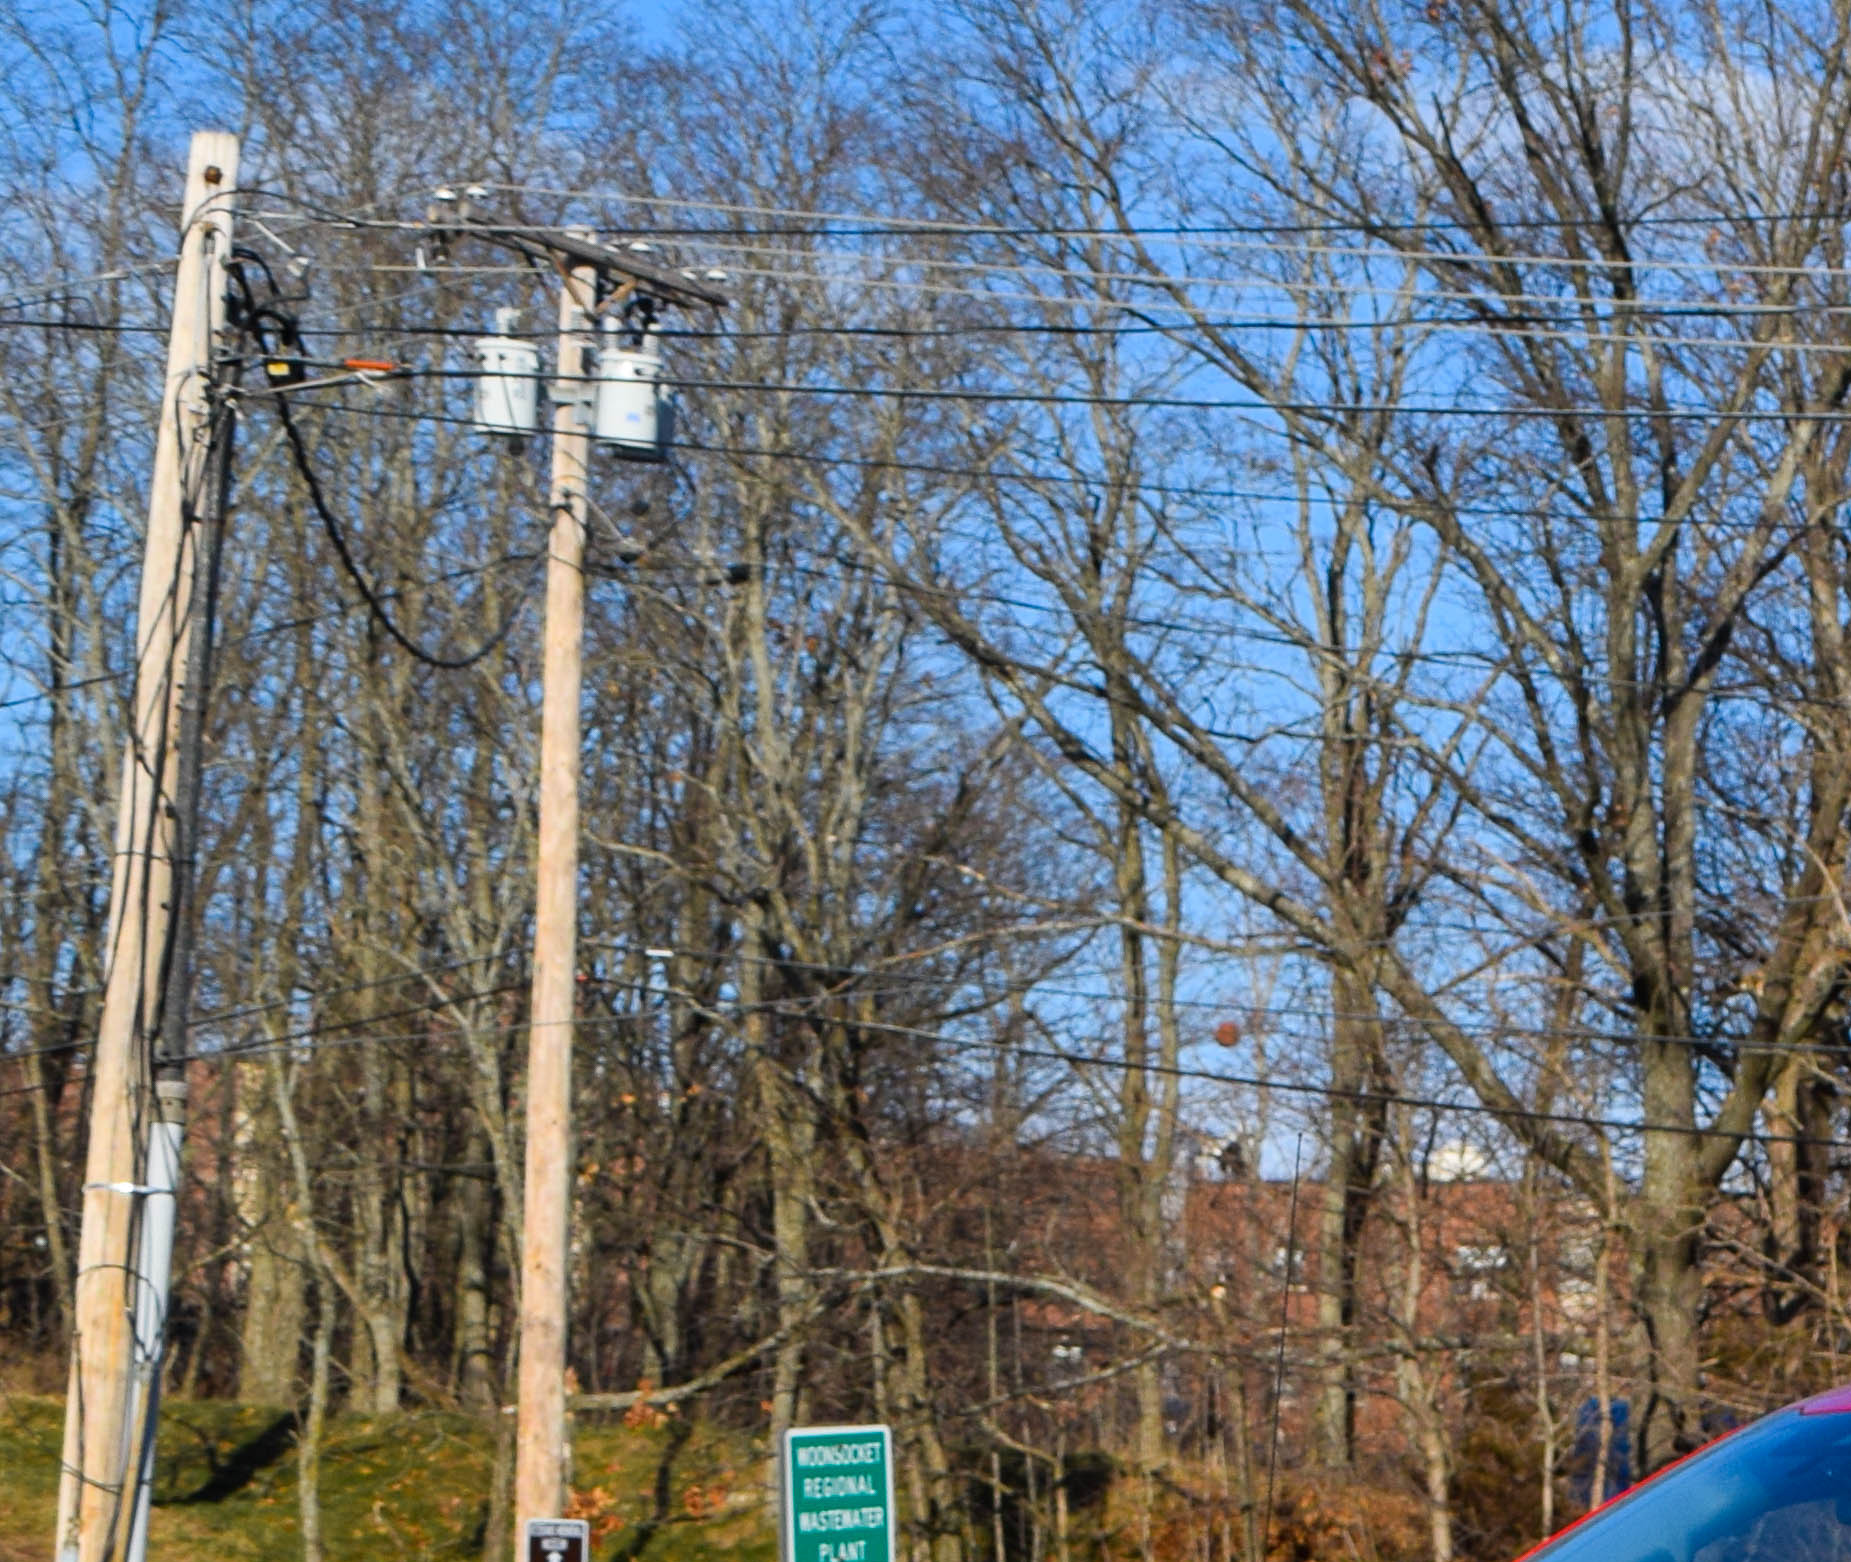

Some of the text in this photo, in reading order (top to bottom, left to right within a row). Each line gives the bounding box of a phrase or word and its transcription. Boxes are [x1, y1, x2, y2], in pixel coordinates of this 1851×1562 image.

[797, 1442, 882, 1467] WOONSOCKET
[803, 1474, 877, 1498] REGIONAL
[799, 1506, 884, 1532] WASTEWATER
[818, 1540, 866, 1562] PLANT
